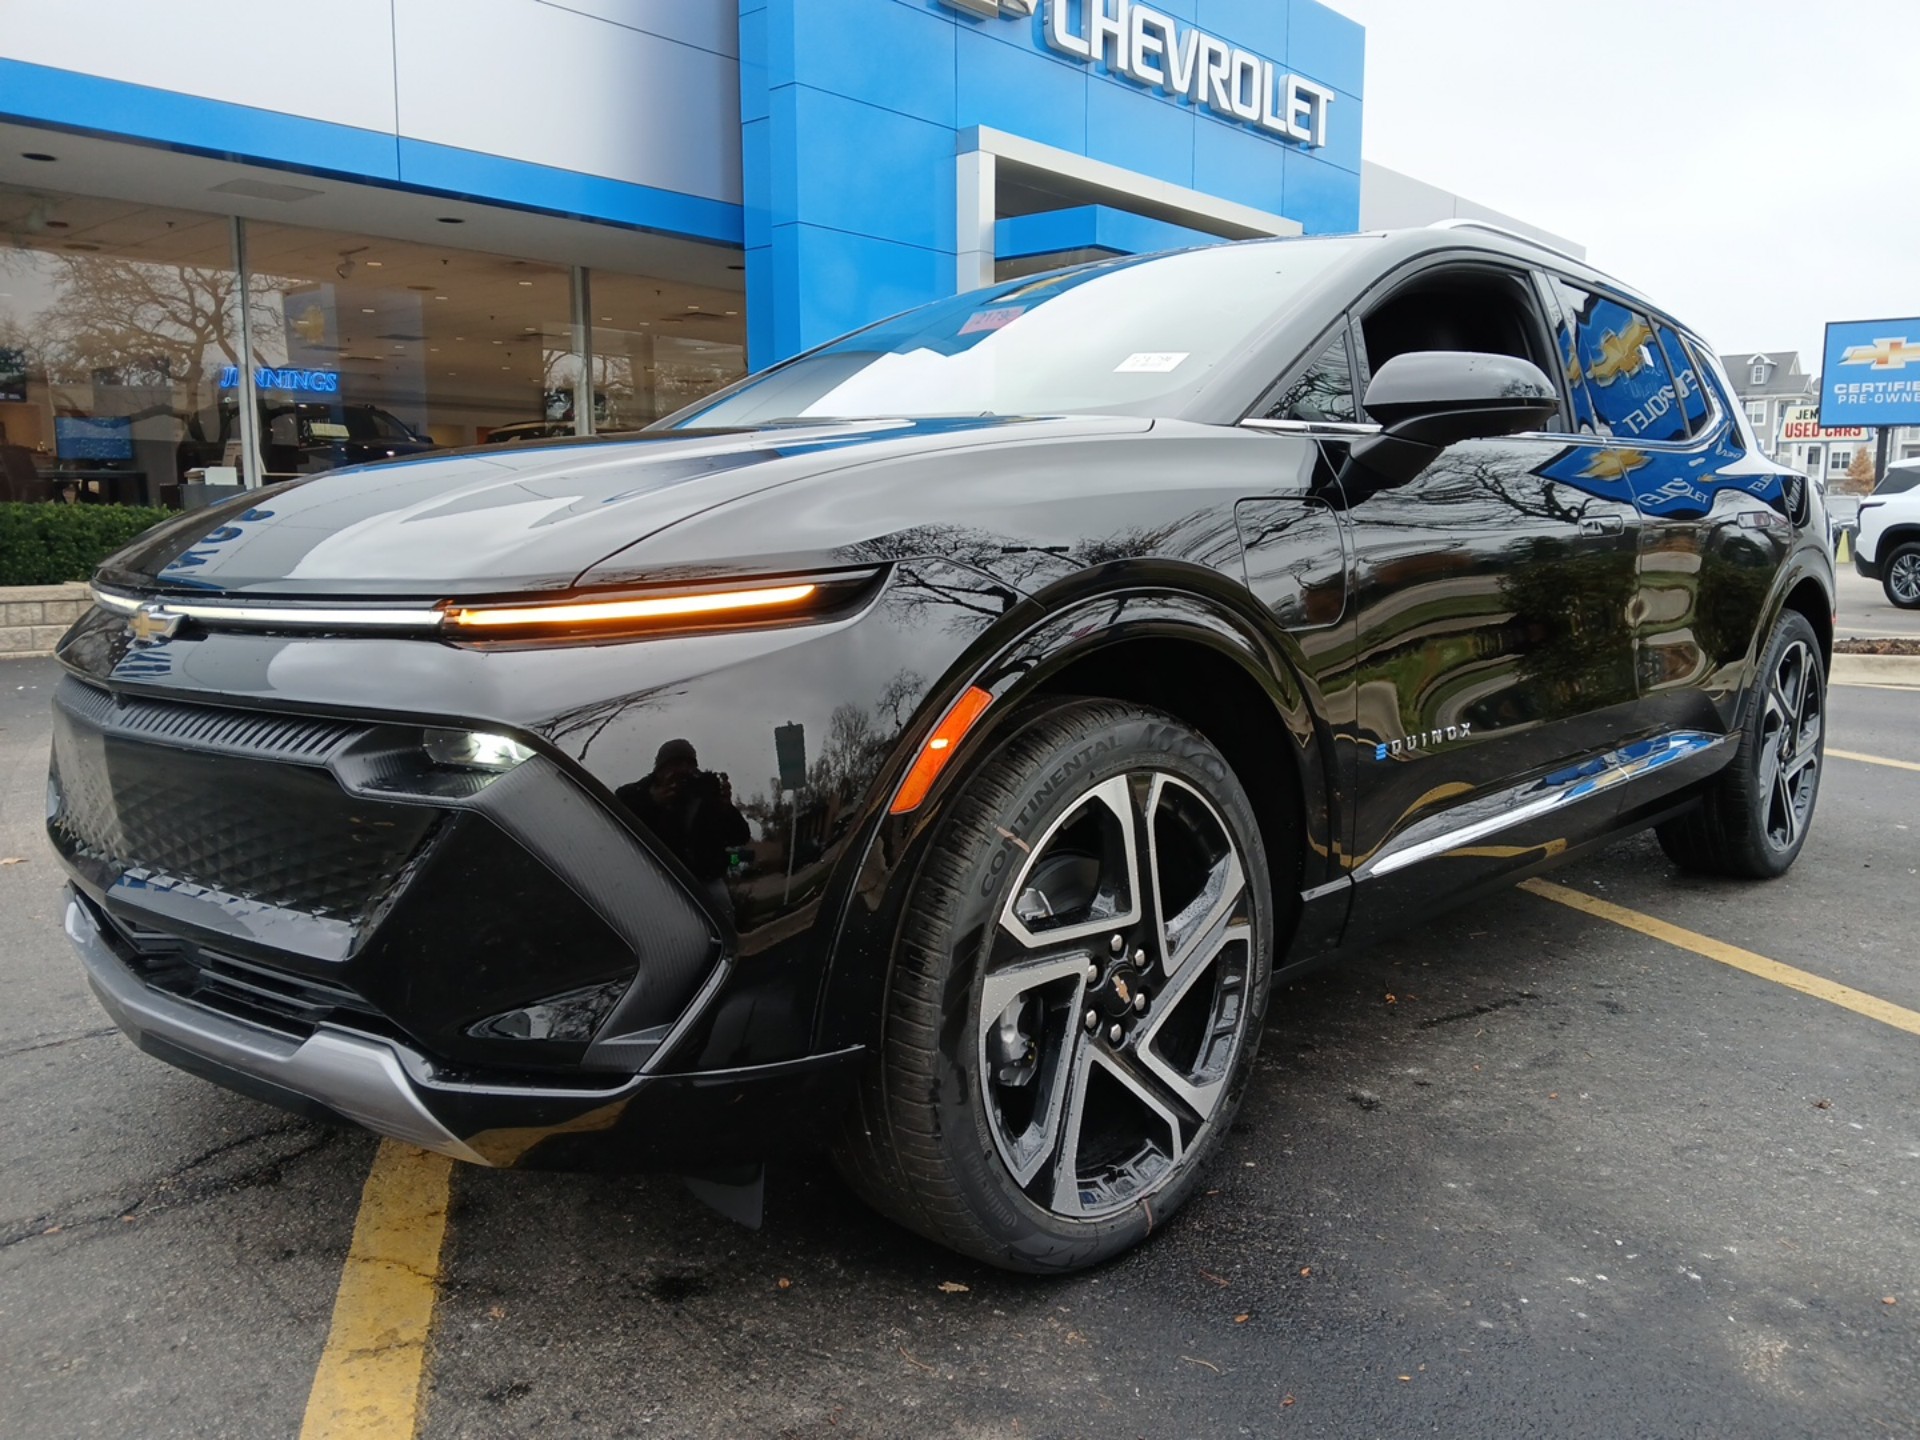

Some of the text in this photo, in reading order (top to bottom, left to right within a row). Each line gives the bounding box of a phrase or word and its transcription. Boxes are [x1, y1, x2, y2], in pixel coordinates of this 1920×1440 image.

[1046, 0, 1335, 147] CHEVROLET
[1785, 422, 1820, 438] USED
[1375, 722, 1472, 760] EQUINOX
[981, 735, 1124, 898] CONTINENTAL
